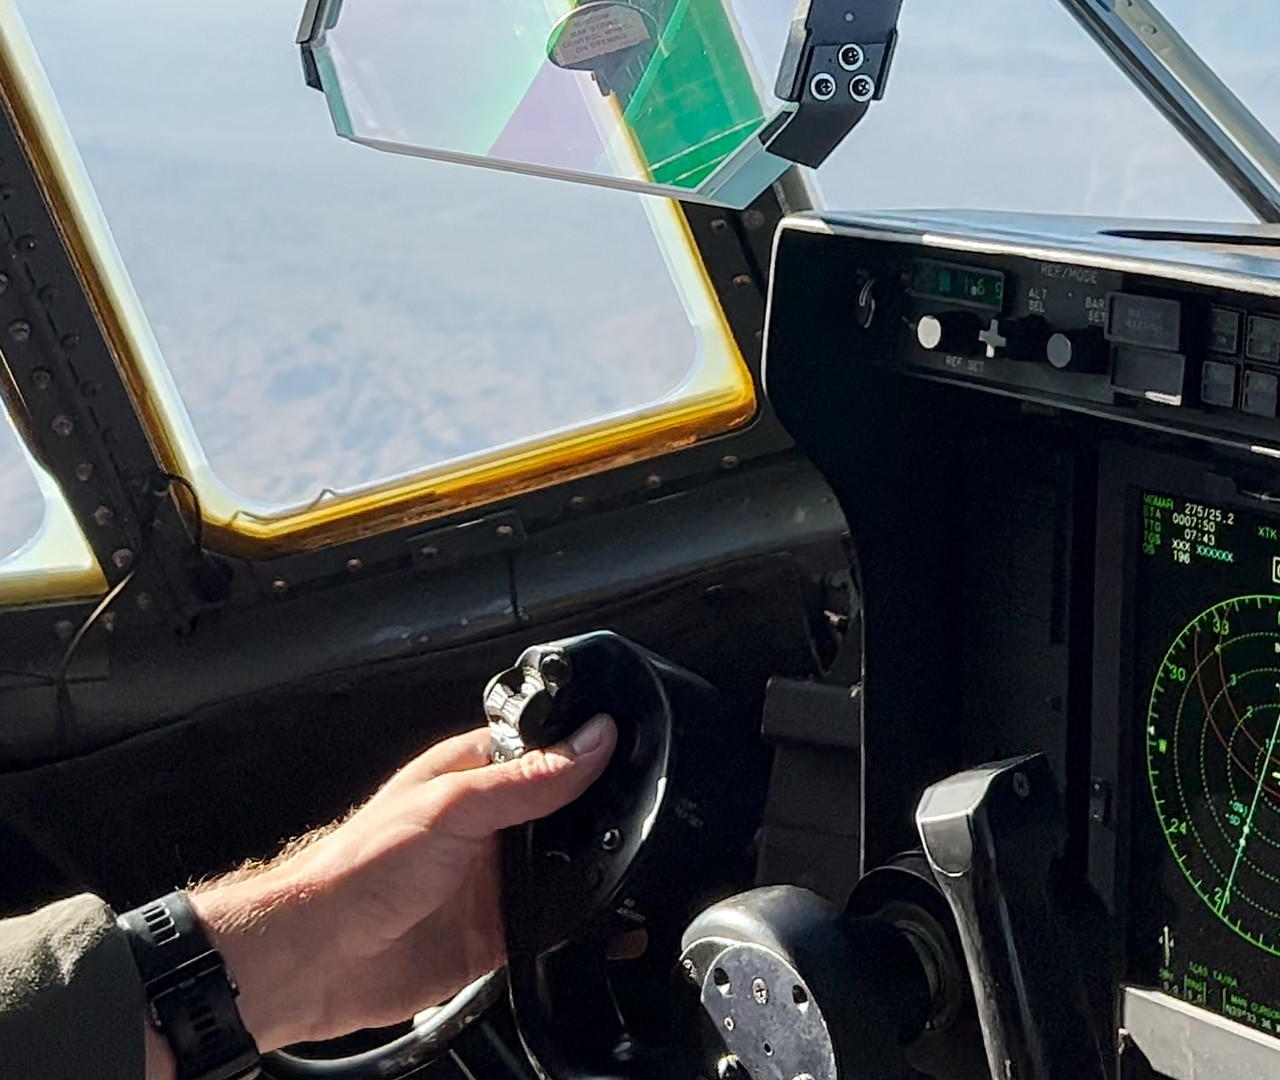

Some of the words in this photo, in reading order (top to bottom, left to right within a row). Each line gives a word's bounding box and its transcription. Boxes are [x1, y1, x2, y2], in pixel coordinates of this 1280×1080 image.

[1040, 263, 1098, 286] REF/MODE
[1027, 288, 1048, 301] ALT
[1084, 297, 1106, 310] BAR
[1028, 300, 1047, 314] SEL
[967, 360, 986, 373] SET
[1172, 512, 1216, 533] 0007:50
[1185, 502, 1235, 525] 275/25.2
[1184, 528, 1216, 546] 07:43
[1258, 525, 1278, 541] XTK
[1171, 537, 1191, 552] XXX
[1212, 617, 1230, 636] 33
[1169, 664, 1187, 682] 30
[1169, 816, 1188, 836] 24
